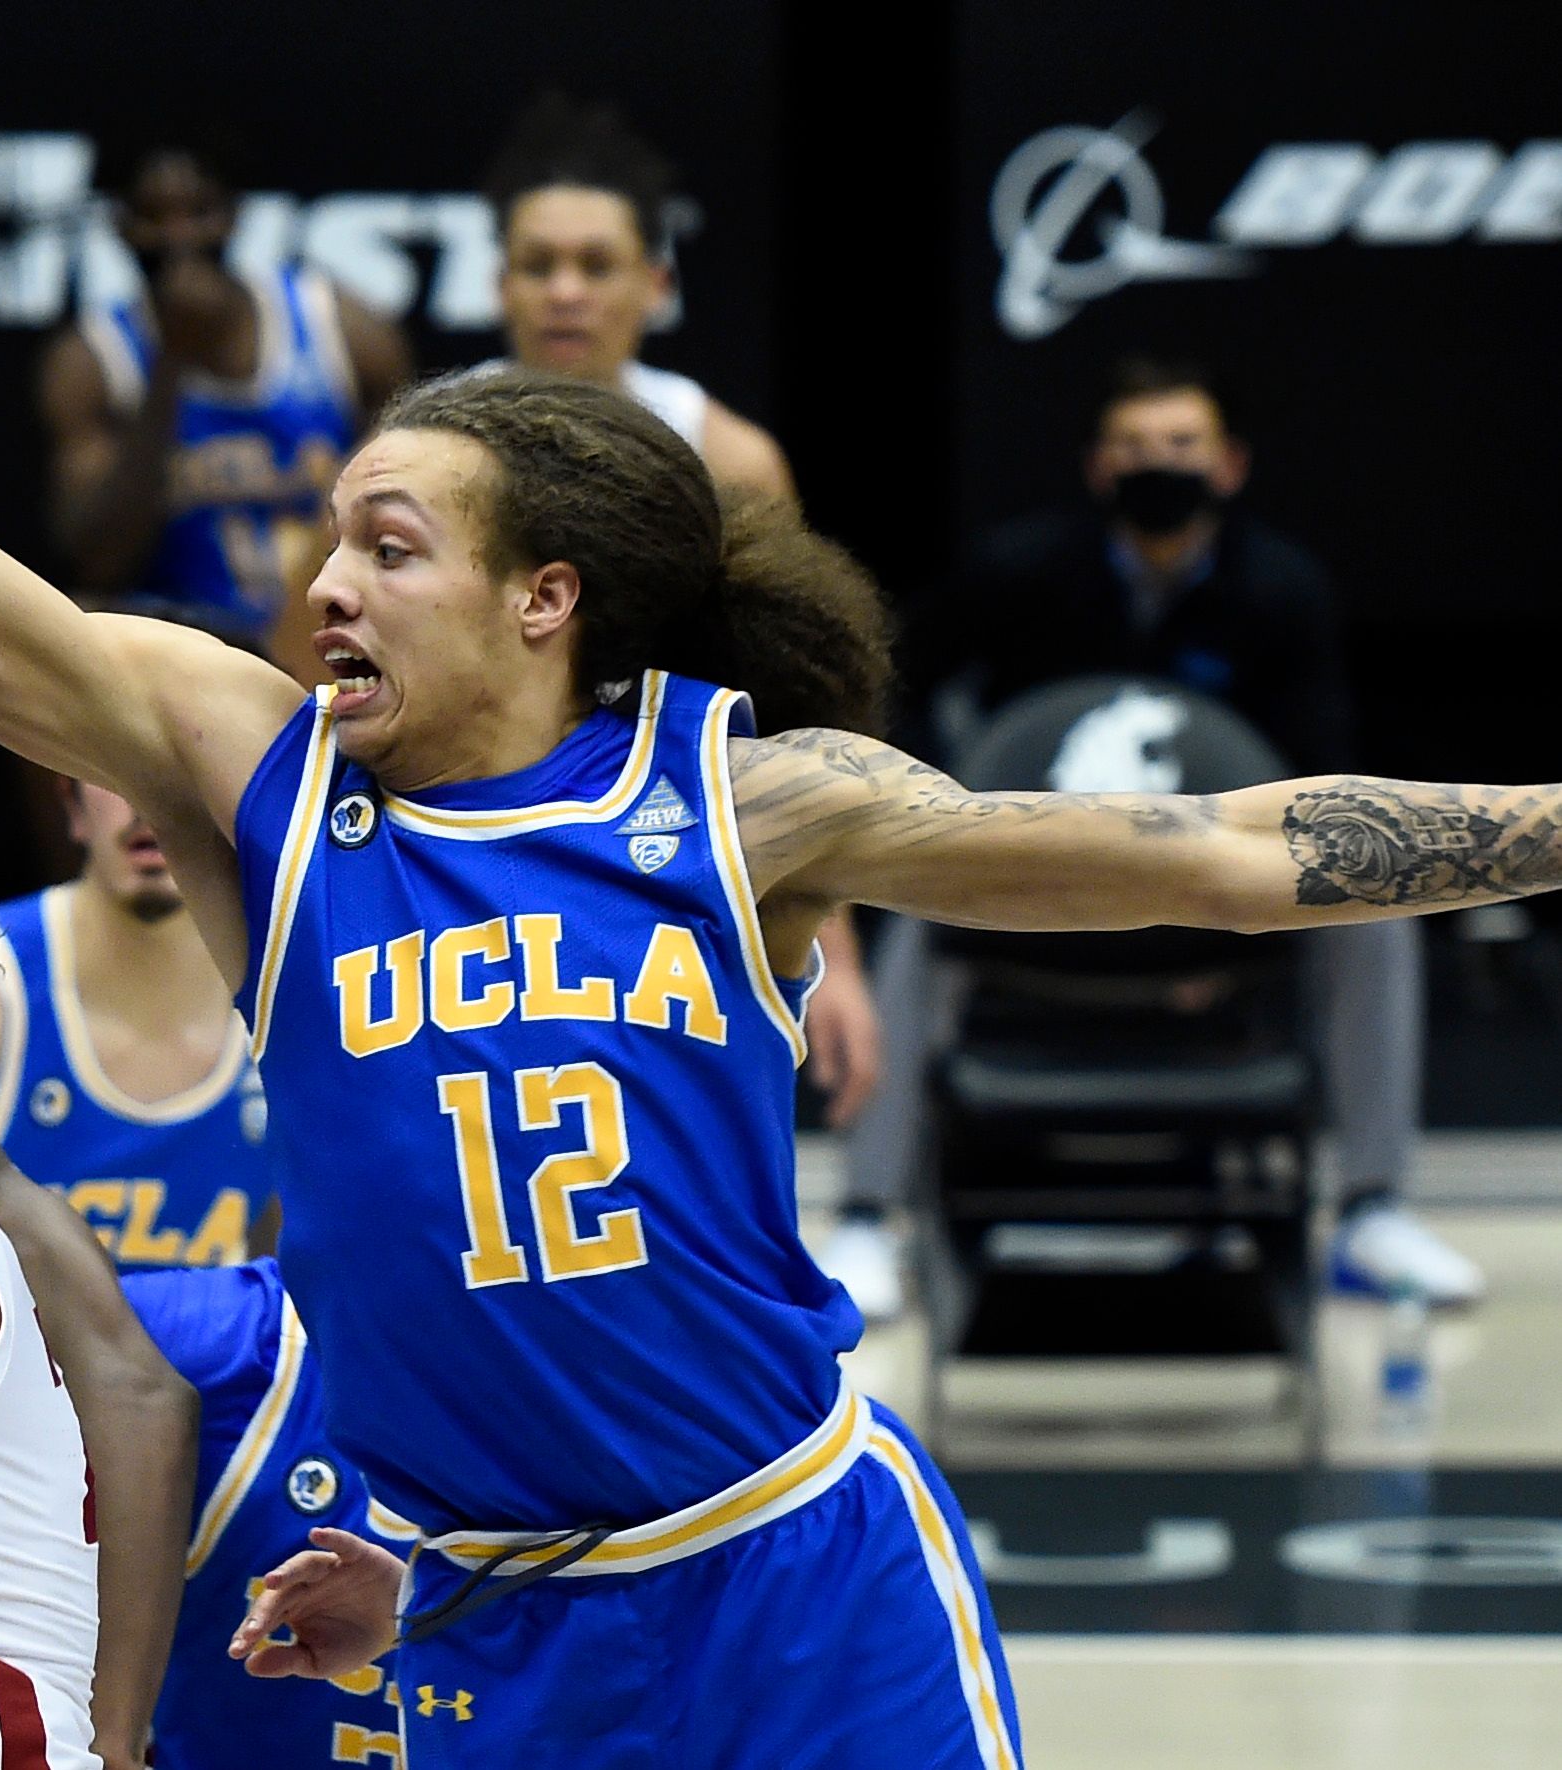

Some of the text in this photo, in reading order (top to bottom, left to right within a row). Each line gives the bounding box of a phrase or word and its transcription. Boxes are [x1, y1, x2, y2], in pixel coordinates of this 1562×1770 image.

[631, 804, 684, 827] JRW
[333, 914, 727, 1058] UCLA
[44, 1177, 249, 1267] CLA
[438, 1062, 648, 1289] 12
